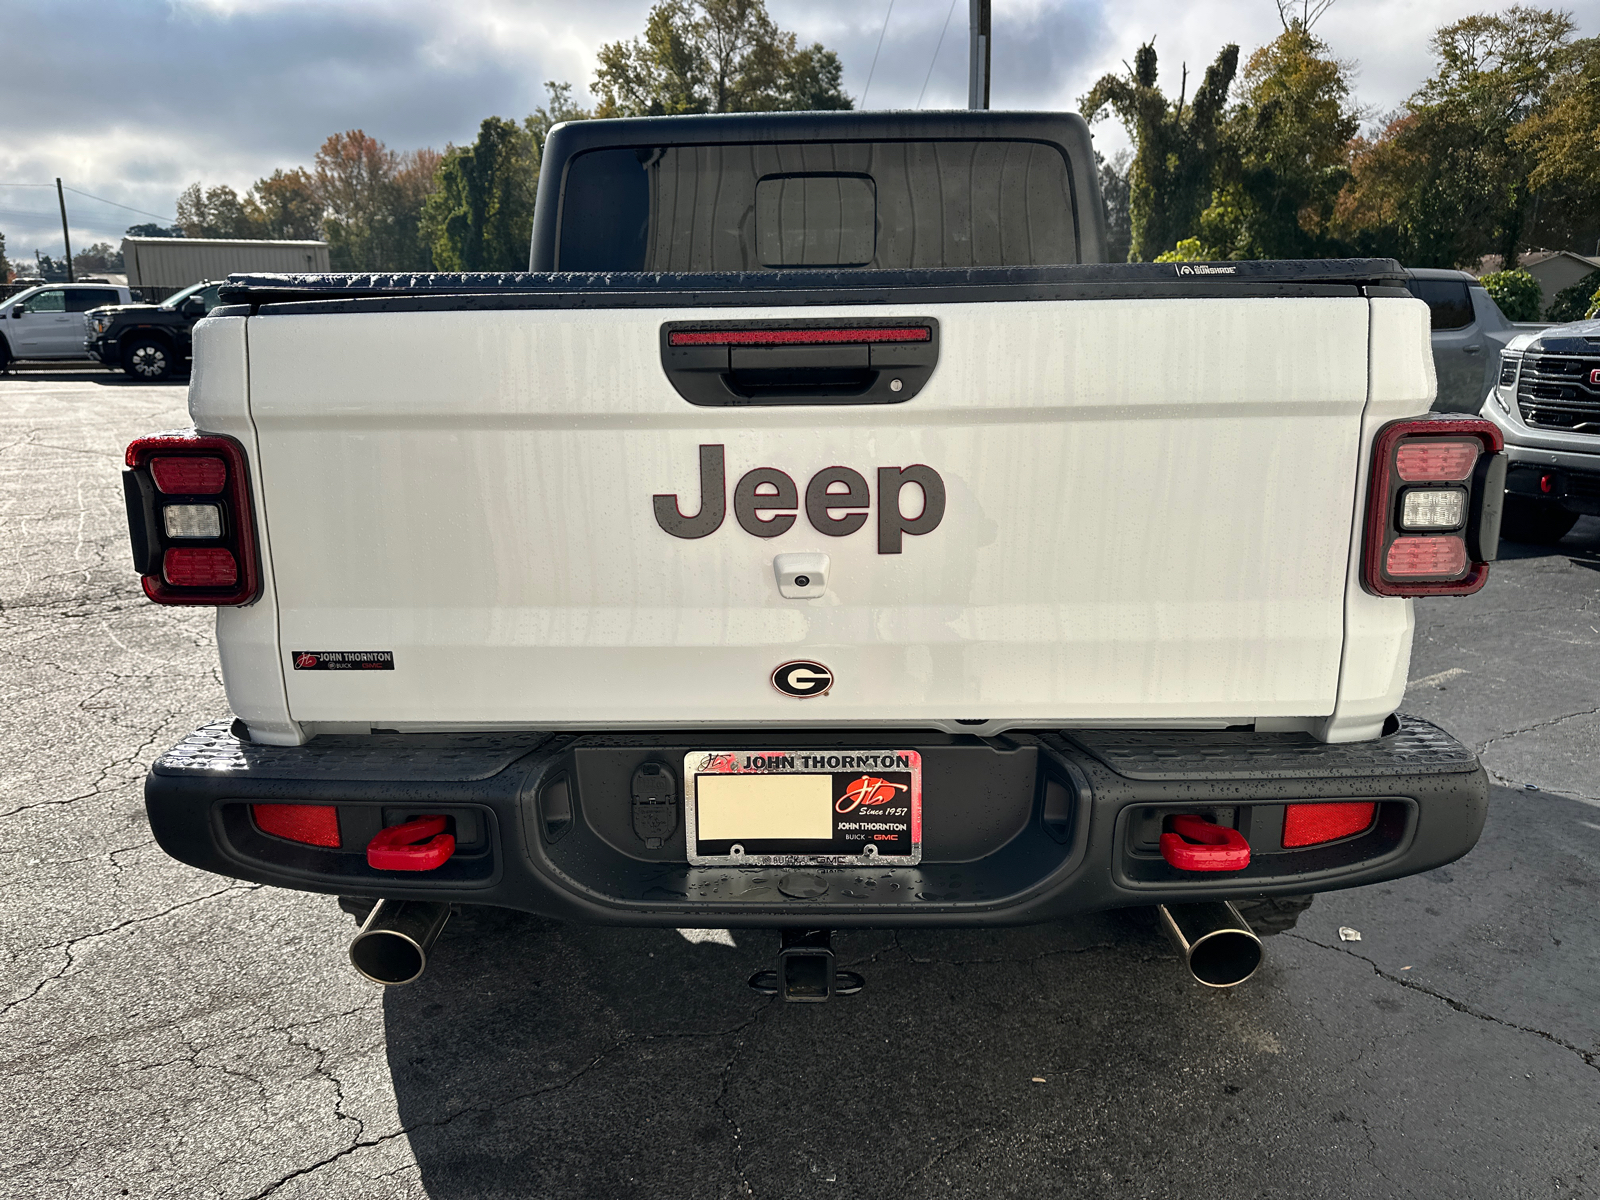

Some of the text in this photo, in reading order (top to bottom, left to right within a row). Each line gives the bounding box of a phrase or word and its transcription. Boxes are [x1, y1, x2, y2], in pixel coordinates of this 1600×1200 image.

[653, 444, 946, 555] Jeep
[320, 652, 391, 662] JOHN THORNTON
[771, 661, 833, 698] G
[743, 755, 909, 769] JOHN THORNTON
[859, 807, 908, 816] Since 1957
[838, 822, 907, 831] JOHN THORNTON
